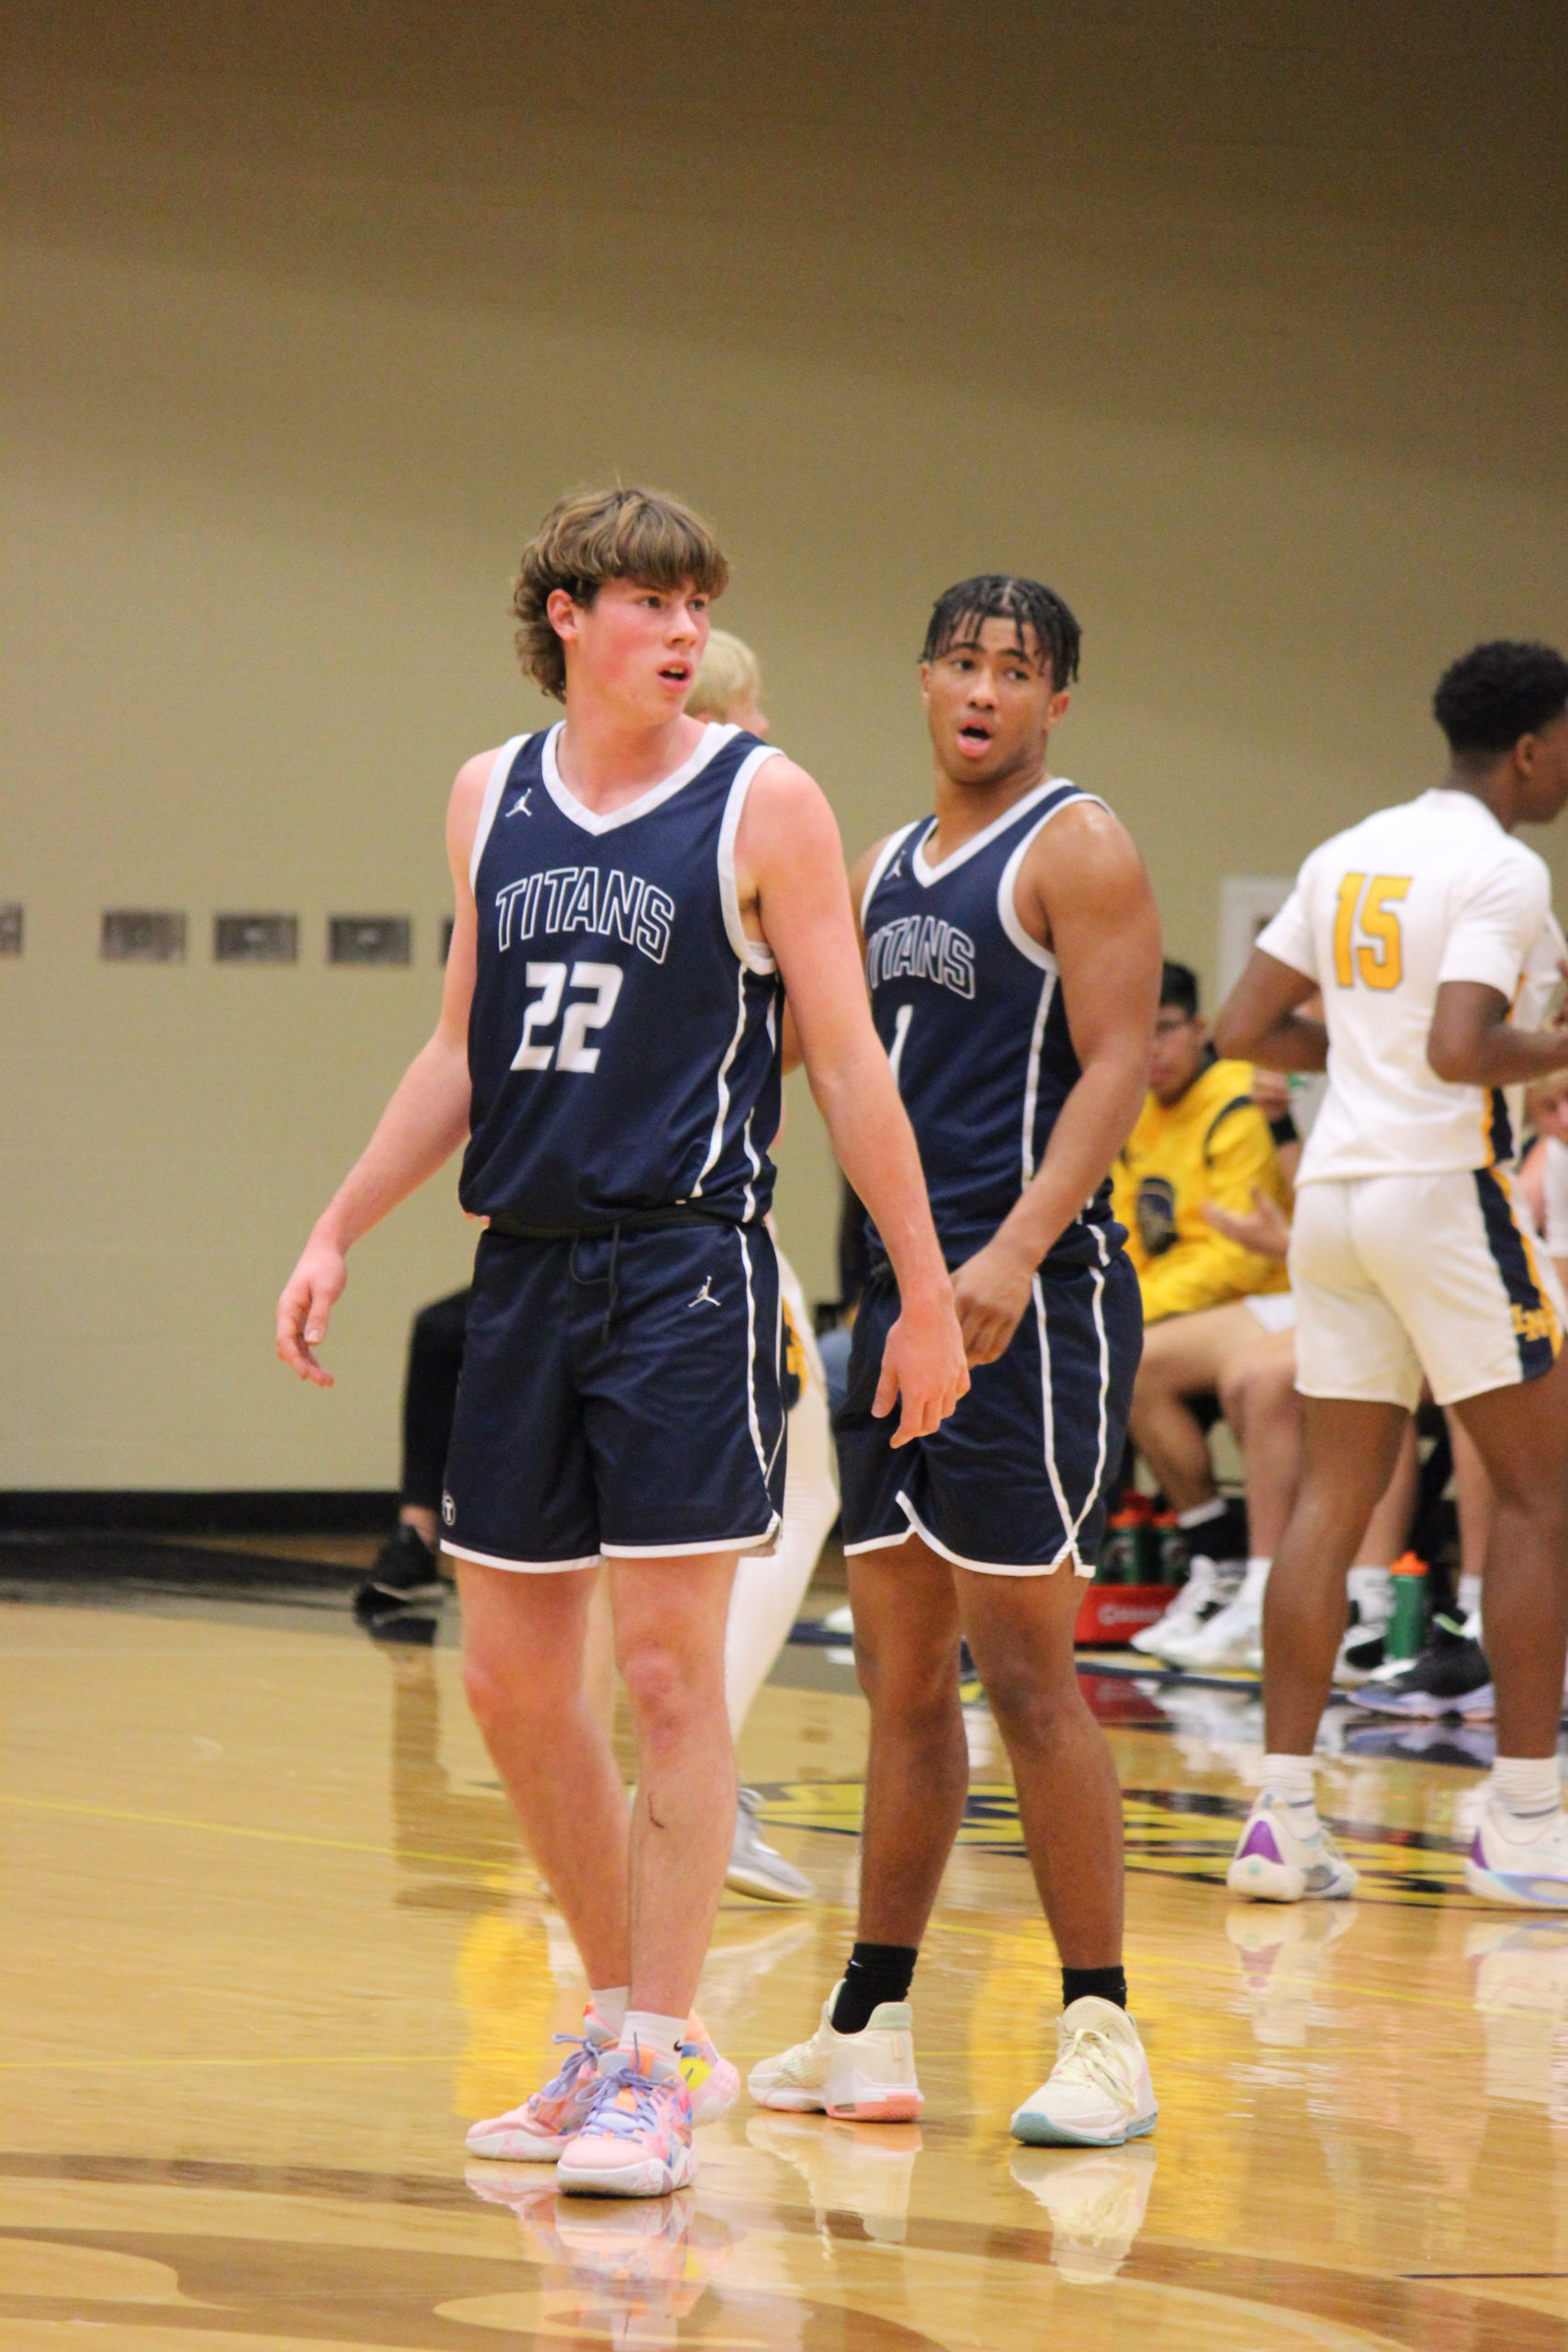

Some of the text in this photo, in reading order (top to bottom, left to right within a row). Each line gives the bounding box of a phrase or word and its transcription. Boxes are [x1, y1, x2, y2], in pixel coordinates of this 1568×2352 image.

[495, 866, 674, 964] TITANS
[867, 914, 976, 1000] ITANS
[1334, 872, 1413, 990] 15
[510, 962, 623, 1073] 22
[888, 1004, 913, 1087] 1
